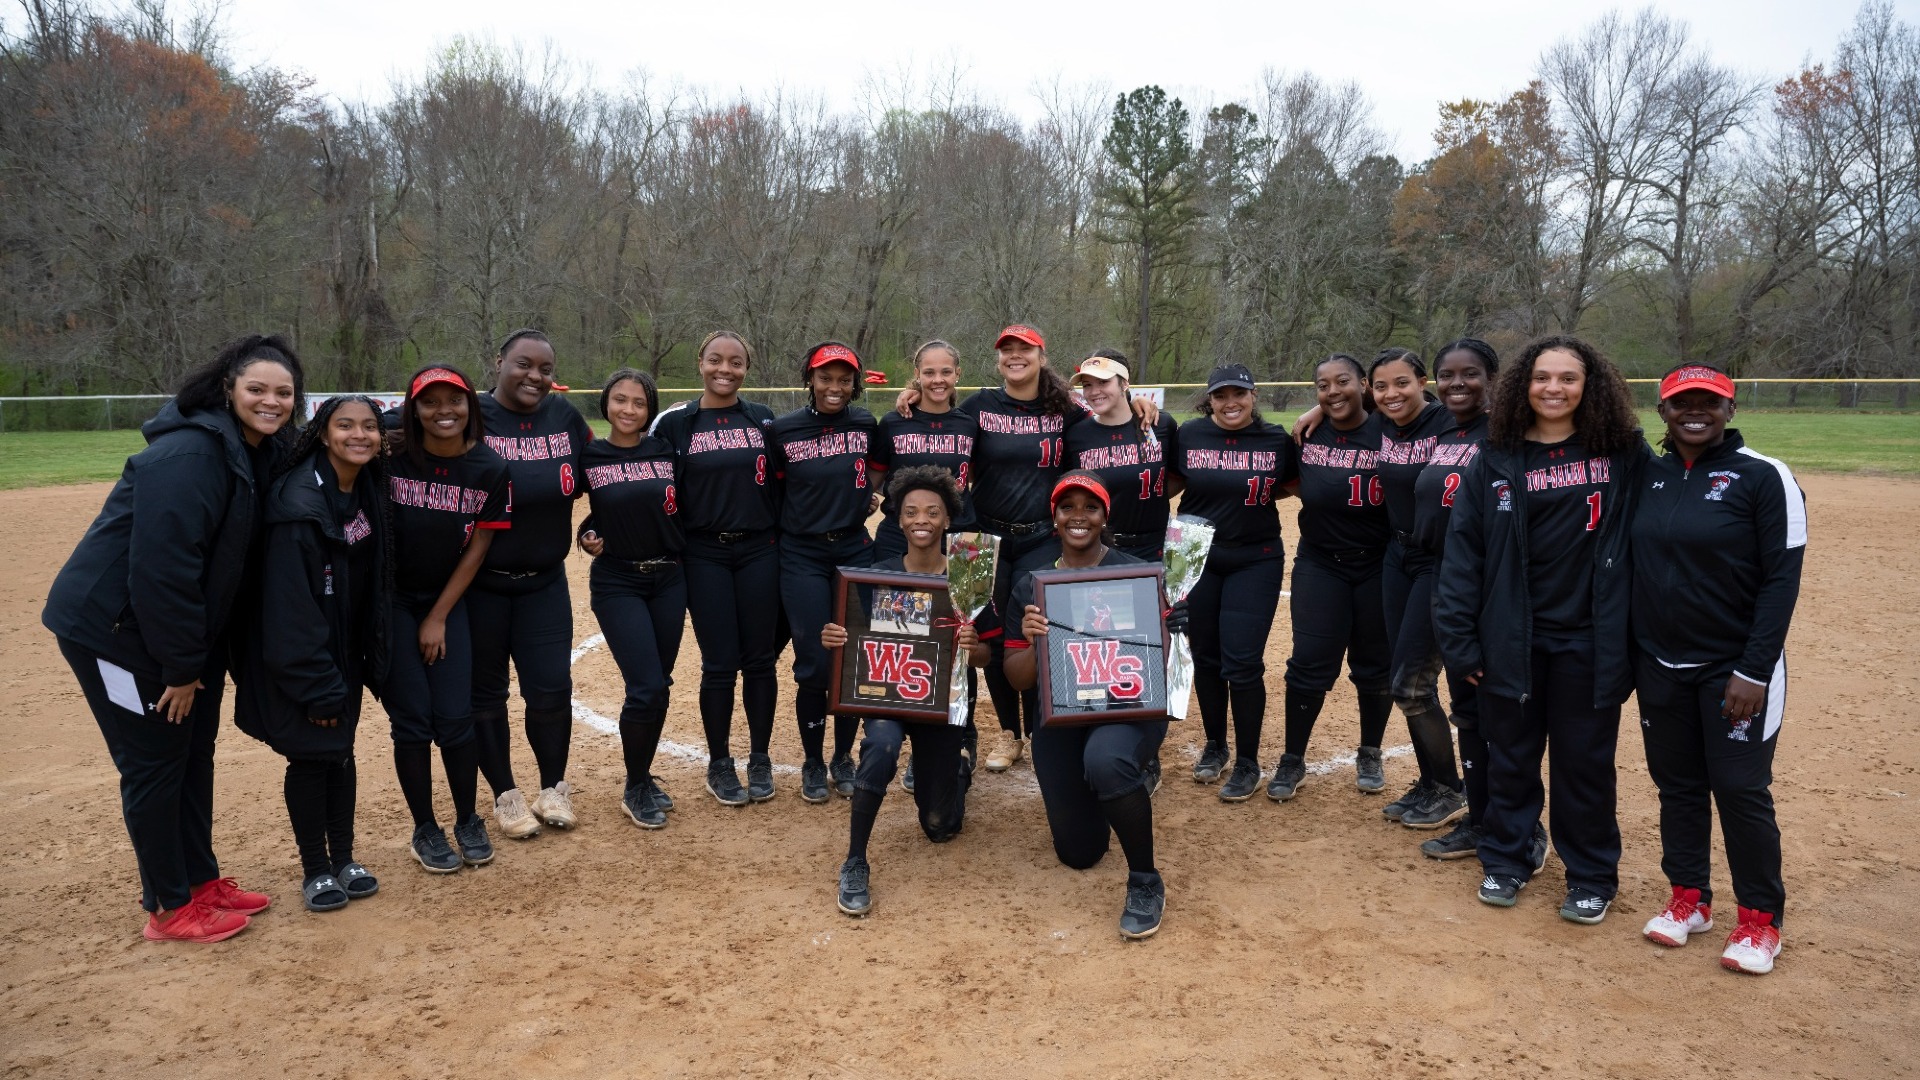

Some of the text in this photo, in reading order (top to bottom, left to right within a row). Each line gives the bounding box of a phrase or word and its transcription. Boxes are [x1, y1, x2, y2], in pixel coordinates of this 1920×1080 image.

[560, 463, 575, 496] 6
[854, 458, 867, 489] 2
[1139, 467, 1166, 500] 14
[1525, 460, 1587, 492] TON-SALEM
[663, 484, 678, 516] 8
[1245, 476, 1277, 506] 15
[1348, 474, 1385, 507] 16
[1586, 491, 1602, 531] 1
[863, 640, 932, 701] WS
[1066, 640, 1144, 699] WS
